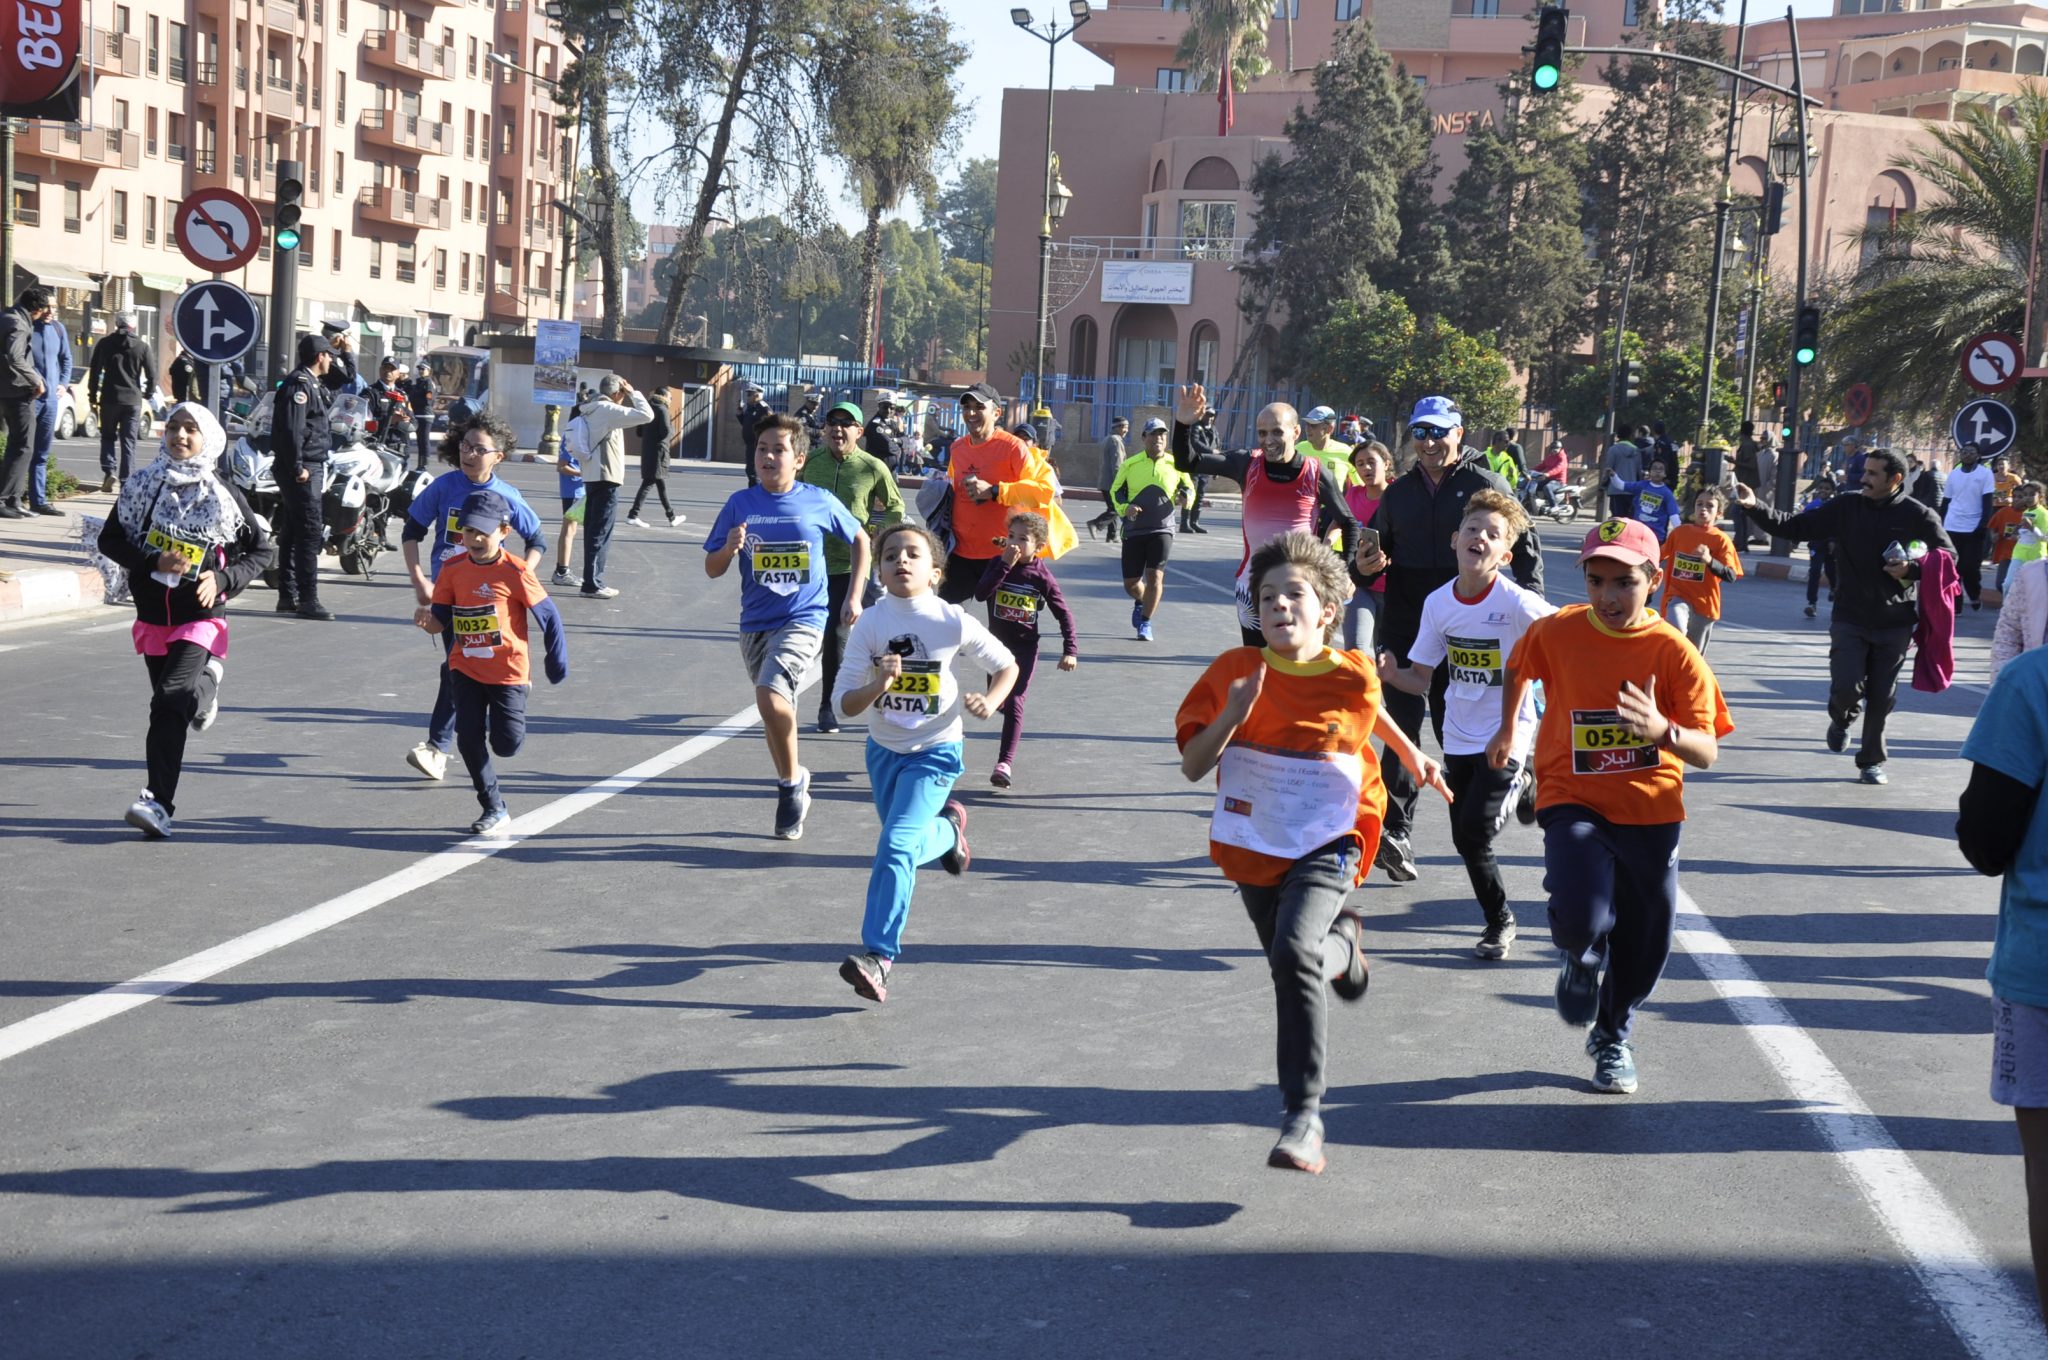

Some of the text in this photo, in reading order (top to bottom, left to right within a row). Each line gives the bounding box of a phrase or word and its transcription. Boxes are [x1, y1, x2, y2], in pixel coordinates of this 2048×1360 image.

[16, 0, 64, 70] BE
[761, 555, 801, 569] 0213
[1677, 560, 1700, 572] 0520
[764, 572, 798, 584] ASTA
[457, 618, 490, 632] 0032
[1453, 650, 1491, 667] 0035
[892, 676, 929, 692] 323
[1457, 669, 1488, 685] ASTA
[883, 694, 925, 713] ASTA
[1595, 751, 1636, 771] البلار
[2001, 1040, 2017, 1085] SIDE
